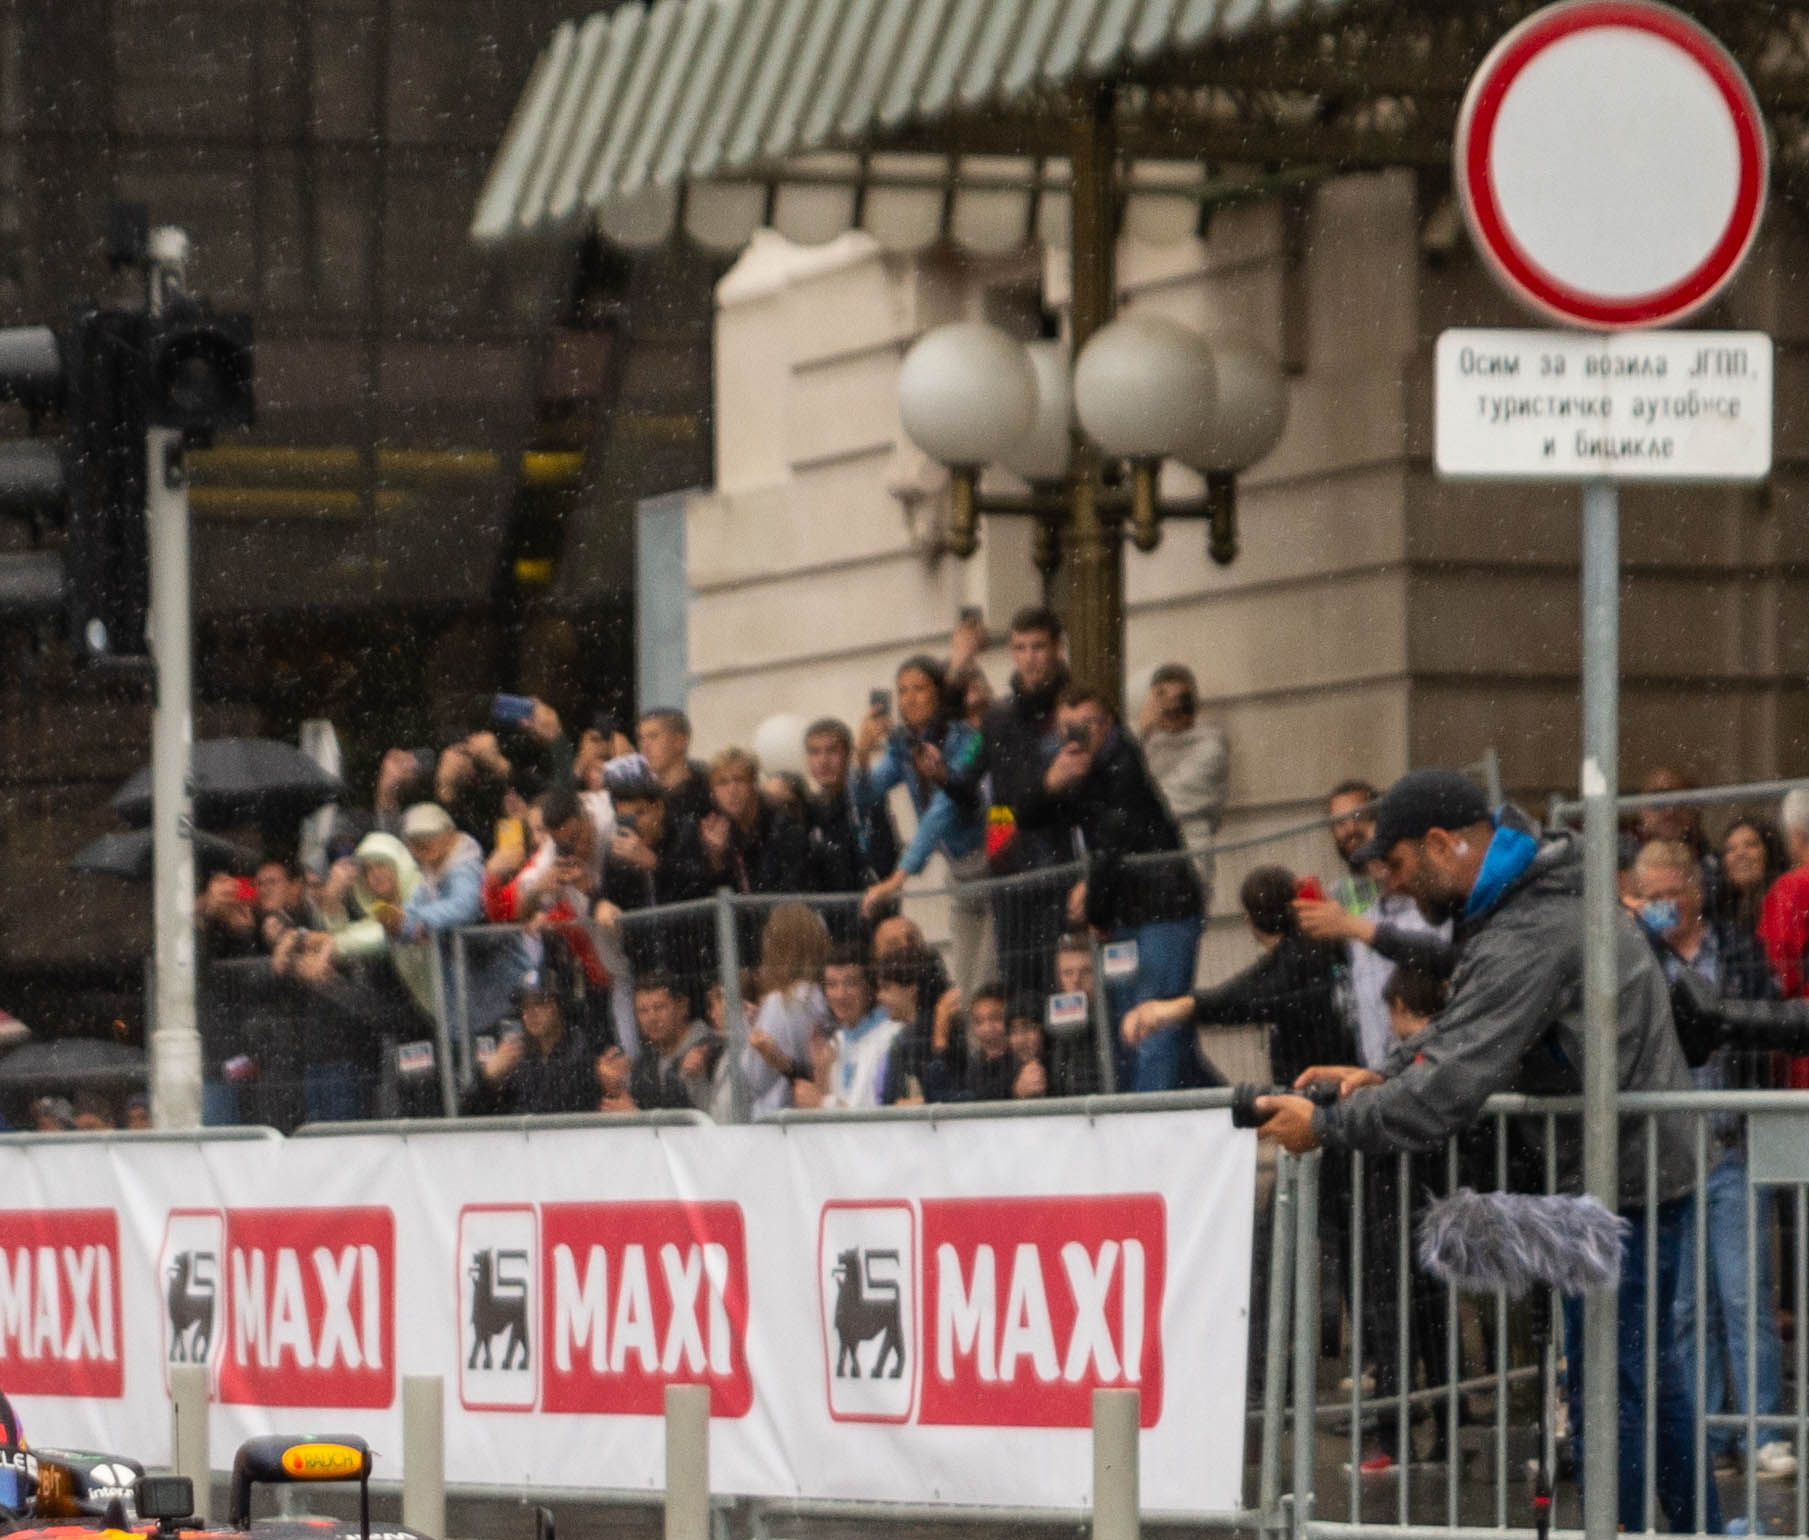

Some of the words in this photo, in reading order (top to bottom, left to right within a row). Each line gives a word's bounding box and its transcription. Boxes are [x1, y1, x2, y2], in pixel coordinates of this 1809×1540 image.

[1459, 346, 1520, 376] Осим
[1540, 355, 1566, 376] за
[1584, 355, 1669, 376] возила
[1477, 393, 1613, 422] туристичке
[1543, 436, 1556, 457] и
[1574, 429, 1675, 461] бицикле
[232, 1243, 383, 1370] MAXI
[552, 1241, 735, 1376] MAXI
[936, 1238, 1146, 1385] MAXI
